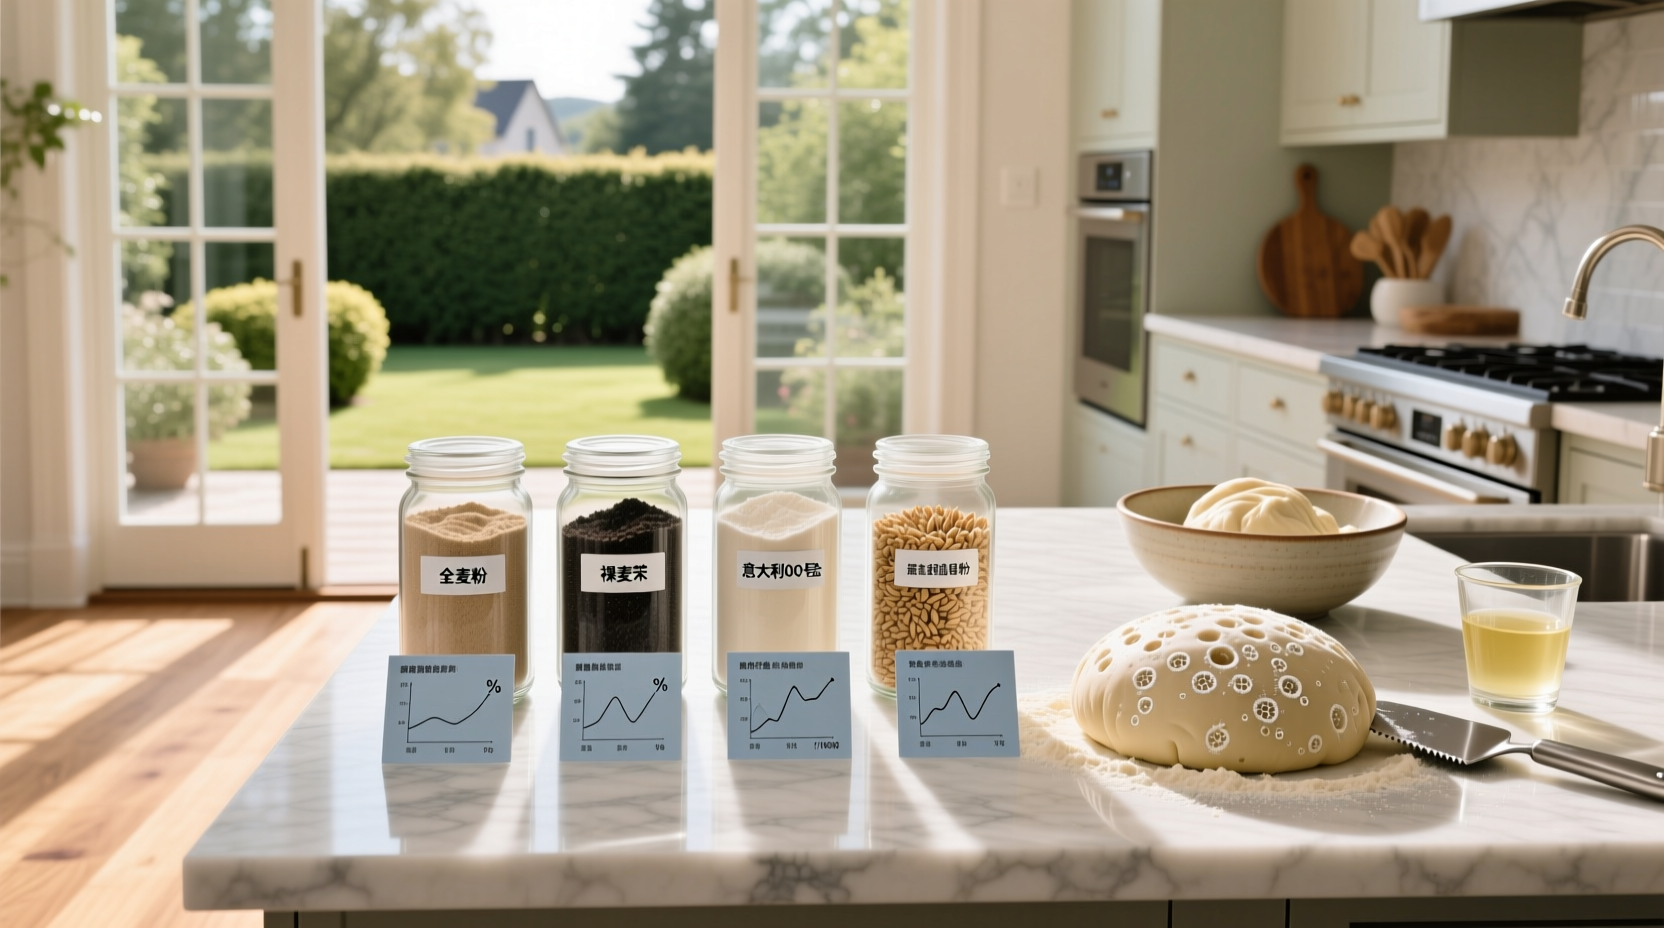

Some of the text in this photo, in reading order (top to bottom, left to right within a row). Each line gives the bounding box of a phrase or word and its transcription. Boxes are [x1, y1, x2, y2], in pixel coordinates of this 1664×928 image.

[439, 566, 488, 584] 全麦粉
[486, 679, 501, 693] %
[653, 677, 668, 692] %
